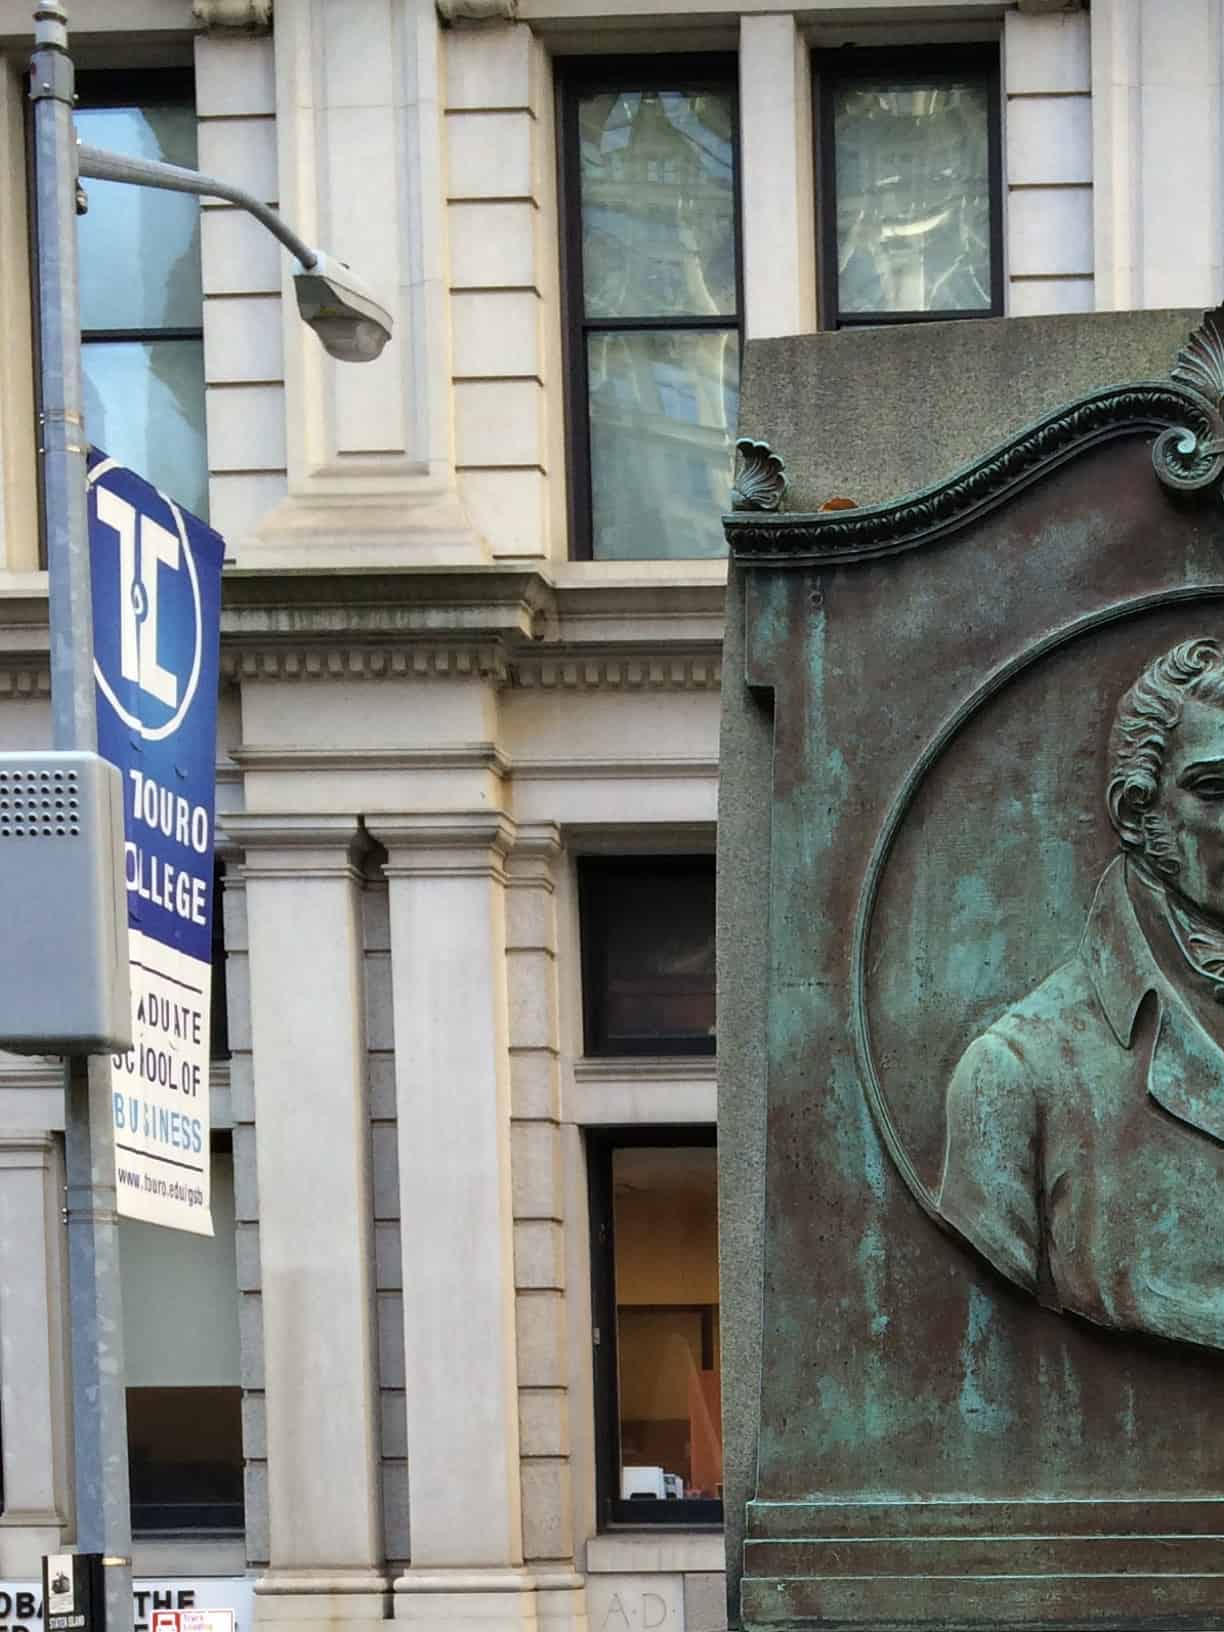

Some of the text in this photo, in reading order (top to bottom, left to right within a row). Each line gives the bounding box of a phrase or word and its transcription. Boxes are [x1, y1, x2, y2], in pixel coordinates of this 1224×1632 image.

[129, 769, 208, 853] TOURO
[125, 841, 207, 926] OLLEGE
[137, 993, 201, 1045] ADUATE
[181, 1060, 201, 1097] OF
[113, 1092, 202, 1153] BUSINESS
[133, 1590, 194, 1618] THE
